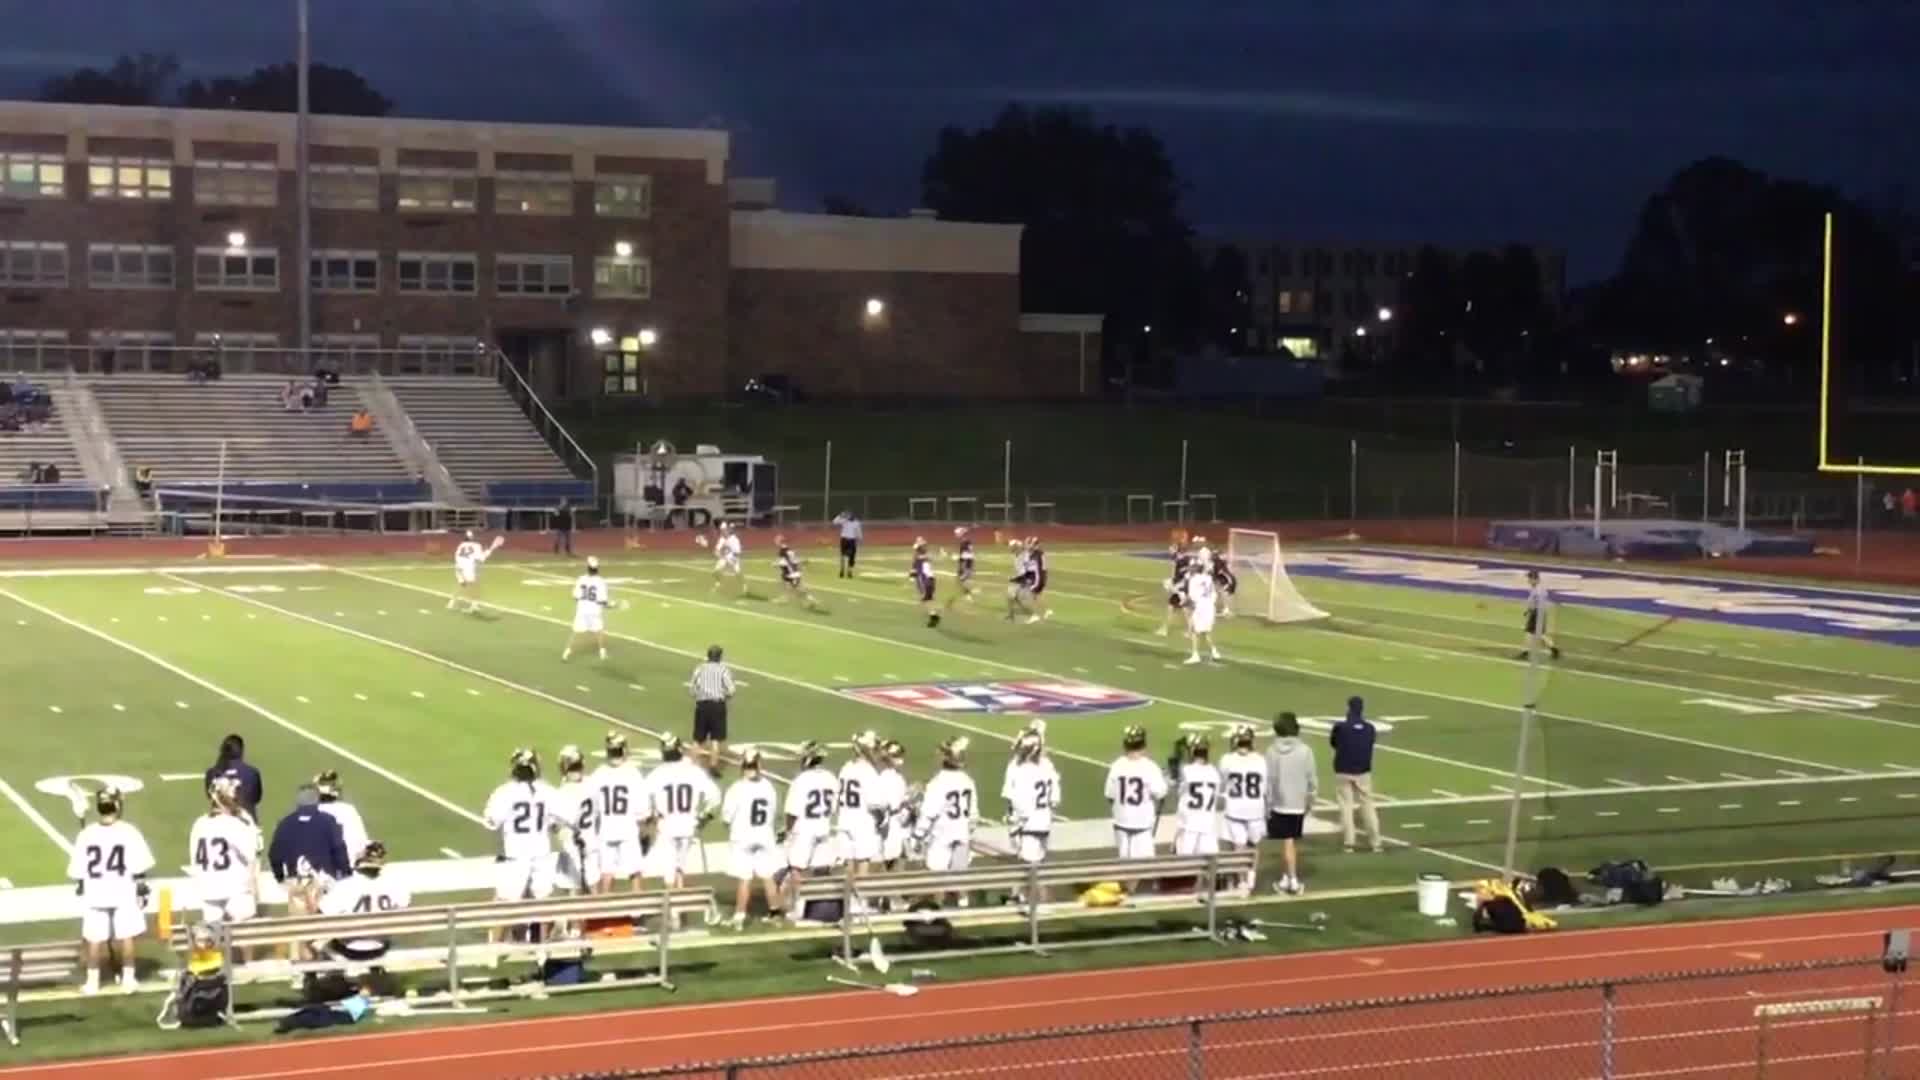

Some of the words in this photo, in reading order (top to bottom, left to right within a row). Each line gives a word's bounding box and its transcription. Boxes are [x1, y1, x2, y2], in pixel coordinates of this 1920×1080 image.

[600, 785, 629, 815] 16
[664, 783, 693, 813] 10
[1118, 775, 1145, 807] 13
[1187, 781, 1217, 812] 57
[1227, 772, 1263, 799] 38
[513, 801, 545, 833] 21
[750, 798, 769, 827] 6
[86, 843, 127, 878] 24
[195, 837, 231, 871] 43
